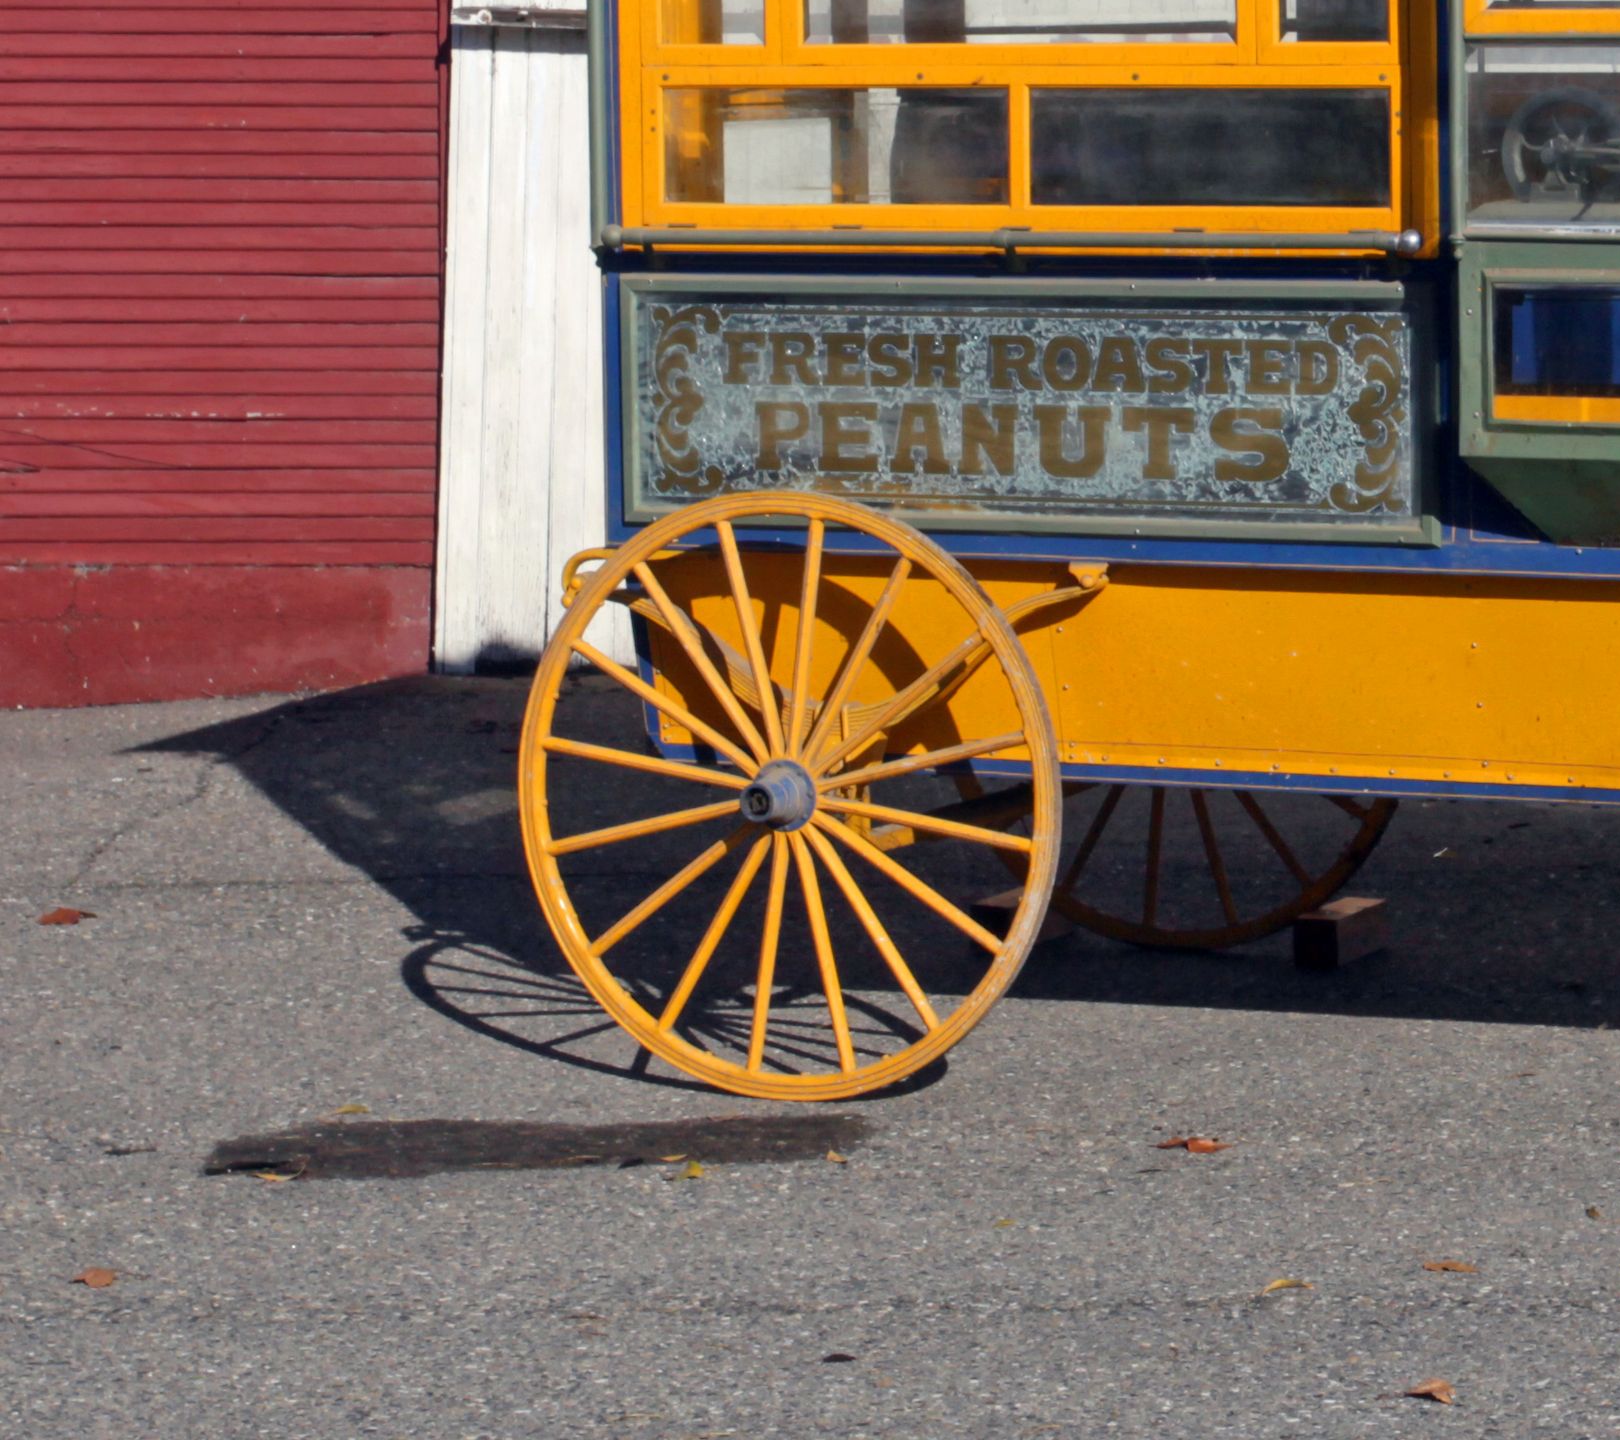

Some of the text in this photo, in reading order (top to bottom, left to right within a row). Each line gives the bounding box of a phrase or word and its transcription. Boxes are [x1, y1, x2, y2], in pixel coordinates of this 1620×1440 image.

[721, 330, 1340, 396] FRESH ROASTED
[753, 400, 1293, 483] PEANUTS
